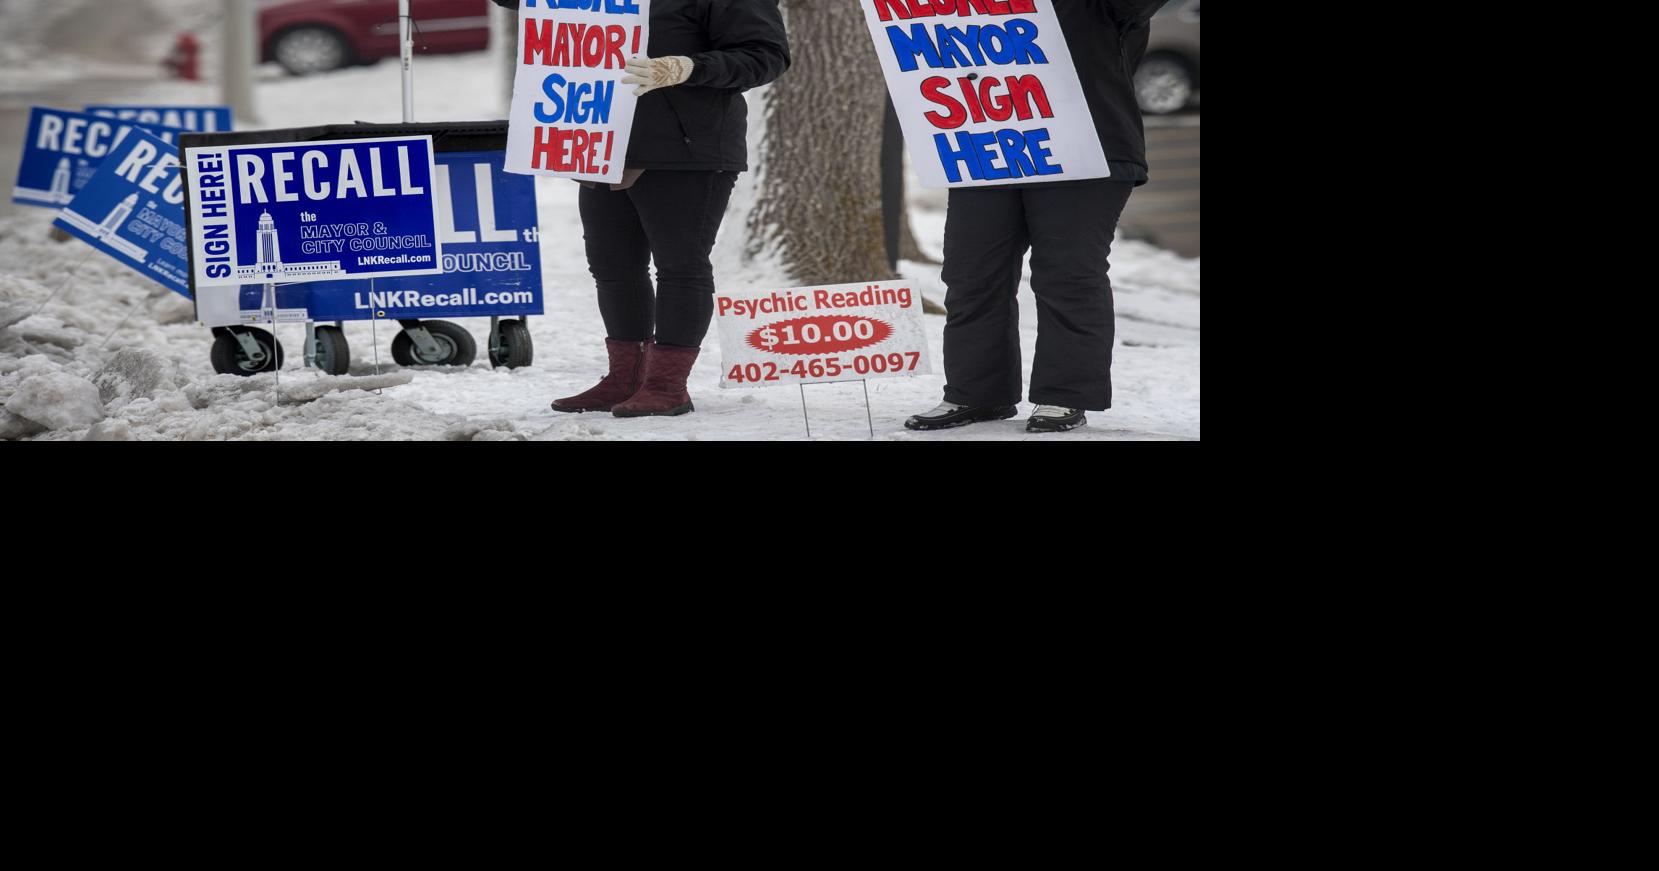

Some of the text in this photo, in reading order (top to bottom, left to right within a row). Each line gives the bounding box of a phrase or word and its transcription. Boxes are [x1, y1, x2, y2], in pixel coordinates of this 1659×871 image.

[523, 18, 641, 70] MAYOR!
[885, 18, 1050, 72] MAYOR
[533, 73, 615, 124] SIGN
[531, 126, 614, 175] HERE!
[933, 127, 1064, 183] HERE
[236, 145, 424, 205] RECALL
[197, 153, 231, 279] SIGN HERE!
[300, 211, 317, 223] the
[300, 221, 388, 240] MAYOR &
[301, 234, 432, 255] CITY COUNCIL
[357, 253, 432, 266] LNKRecall.com
[442, 251, 532, 274] OUNCIL
[354, 287, 534, 310] LNKRecall.com
[717, 284, 912, 319] Psychic Reading
[759, 319, 874, 350] $10.00
[727, 351, 921, 384] 402-465-0097
